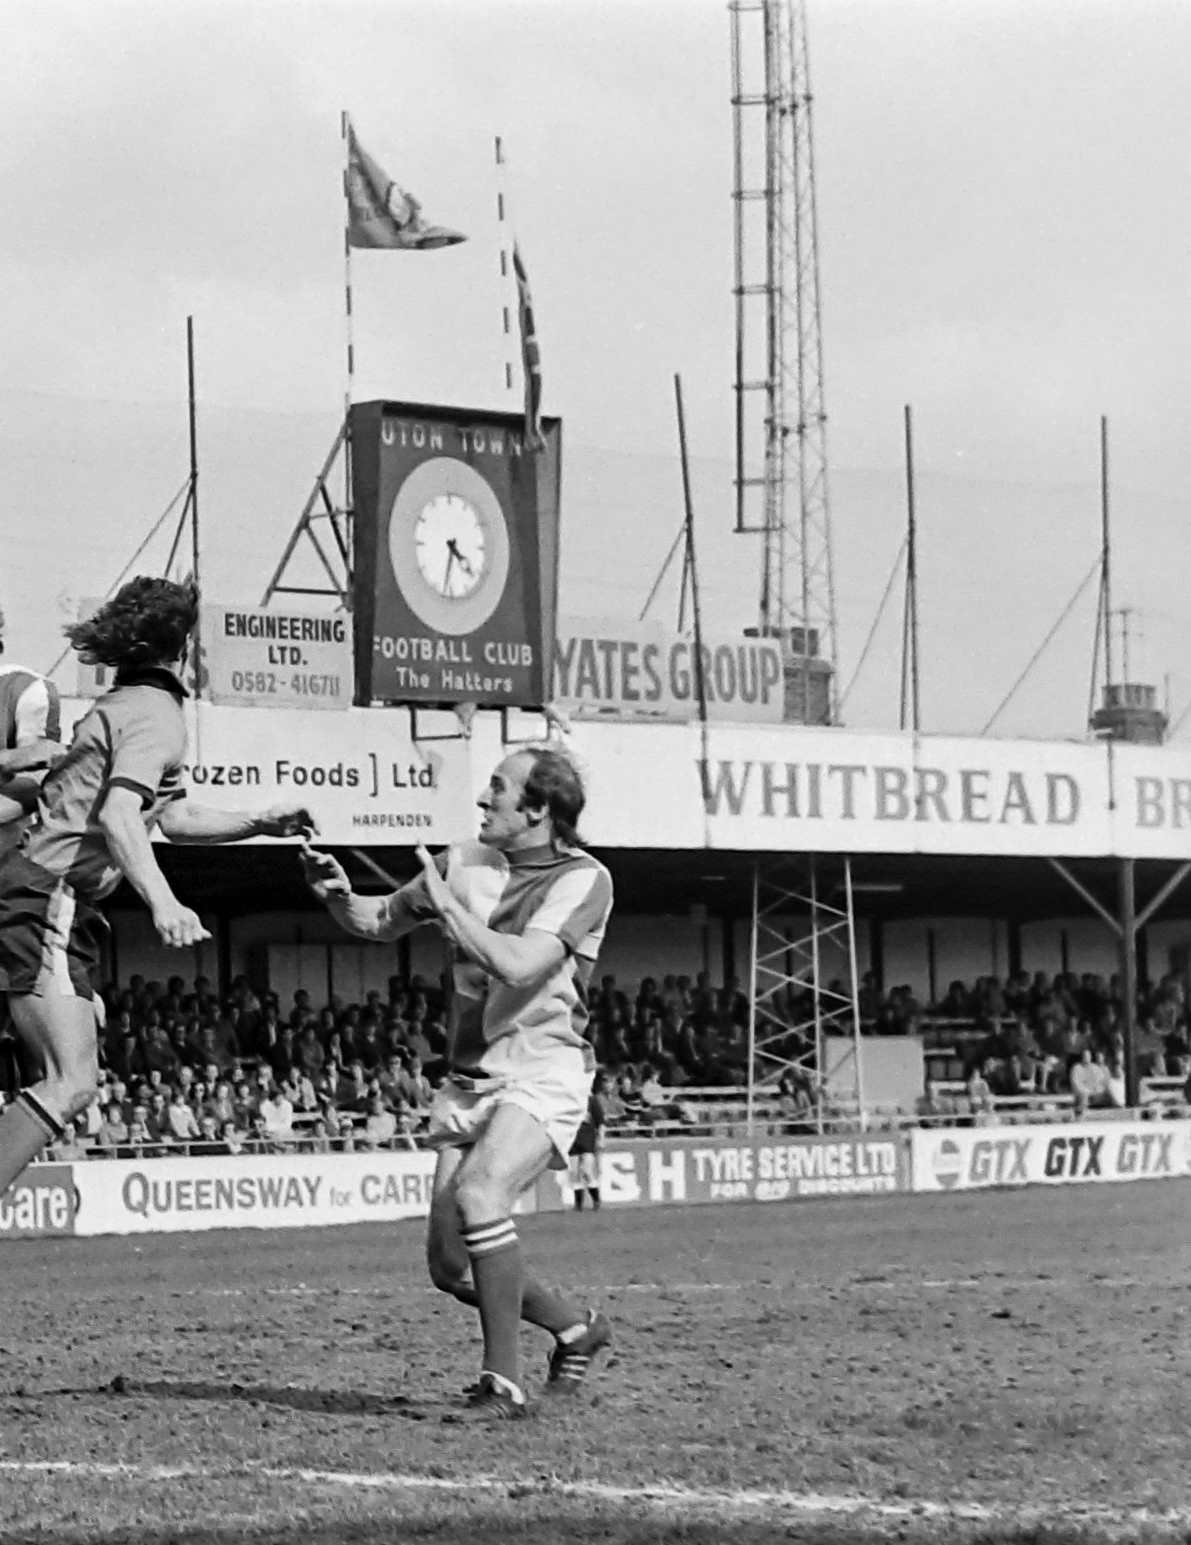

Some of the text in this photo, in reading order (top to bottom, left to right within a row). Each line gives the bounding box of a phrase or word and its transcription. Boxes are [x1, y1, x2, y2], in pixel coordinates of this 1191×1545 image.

[381, 420, 522, 457] UTON TOWN
[224, 612, 346, 643] ENGINEERING
[268, 644, 309, 666] LTD.
[484, 641, 534, 667] CLUB
[554, 637, 780, 704] YATES GROUP
[396, 665, 514, 693] The Hatters
[695, 759, 1081, 826] WHITBREAD
[352, 813, 433, 828] HARPENDEN
[648, 1148, 686, 1201] H
[692, 1147, 754, 1182] TYRE
[759, 1142, 852, 1179] SERVICE
[856, 1141, 896, 1175] LTD
[968, 1132, 1175, 1183] GTX GTX GTX
[121, 1171, 322, 1218] QUEENSWAY
[328, 1186, 353, 1207] for
